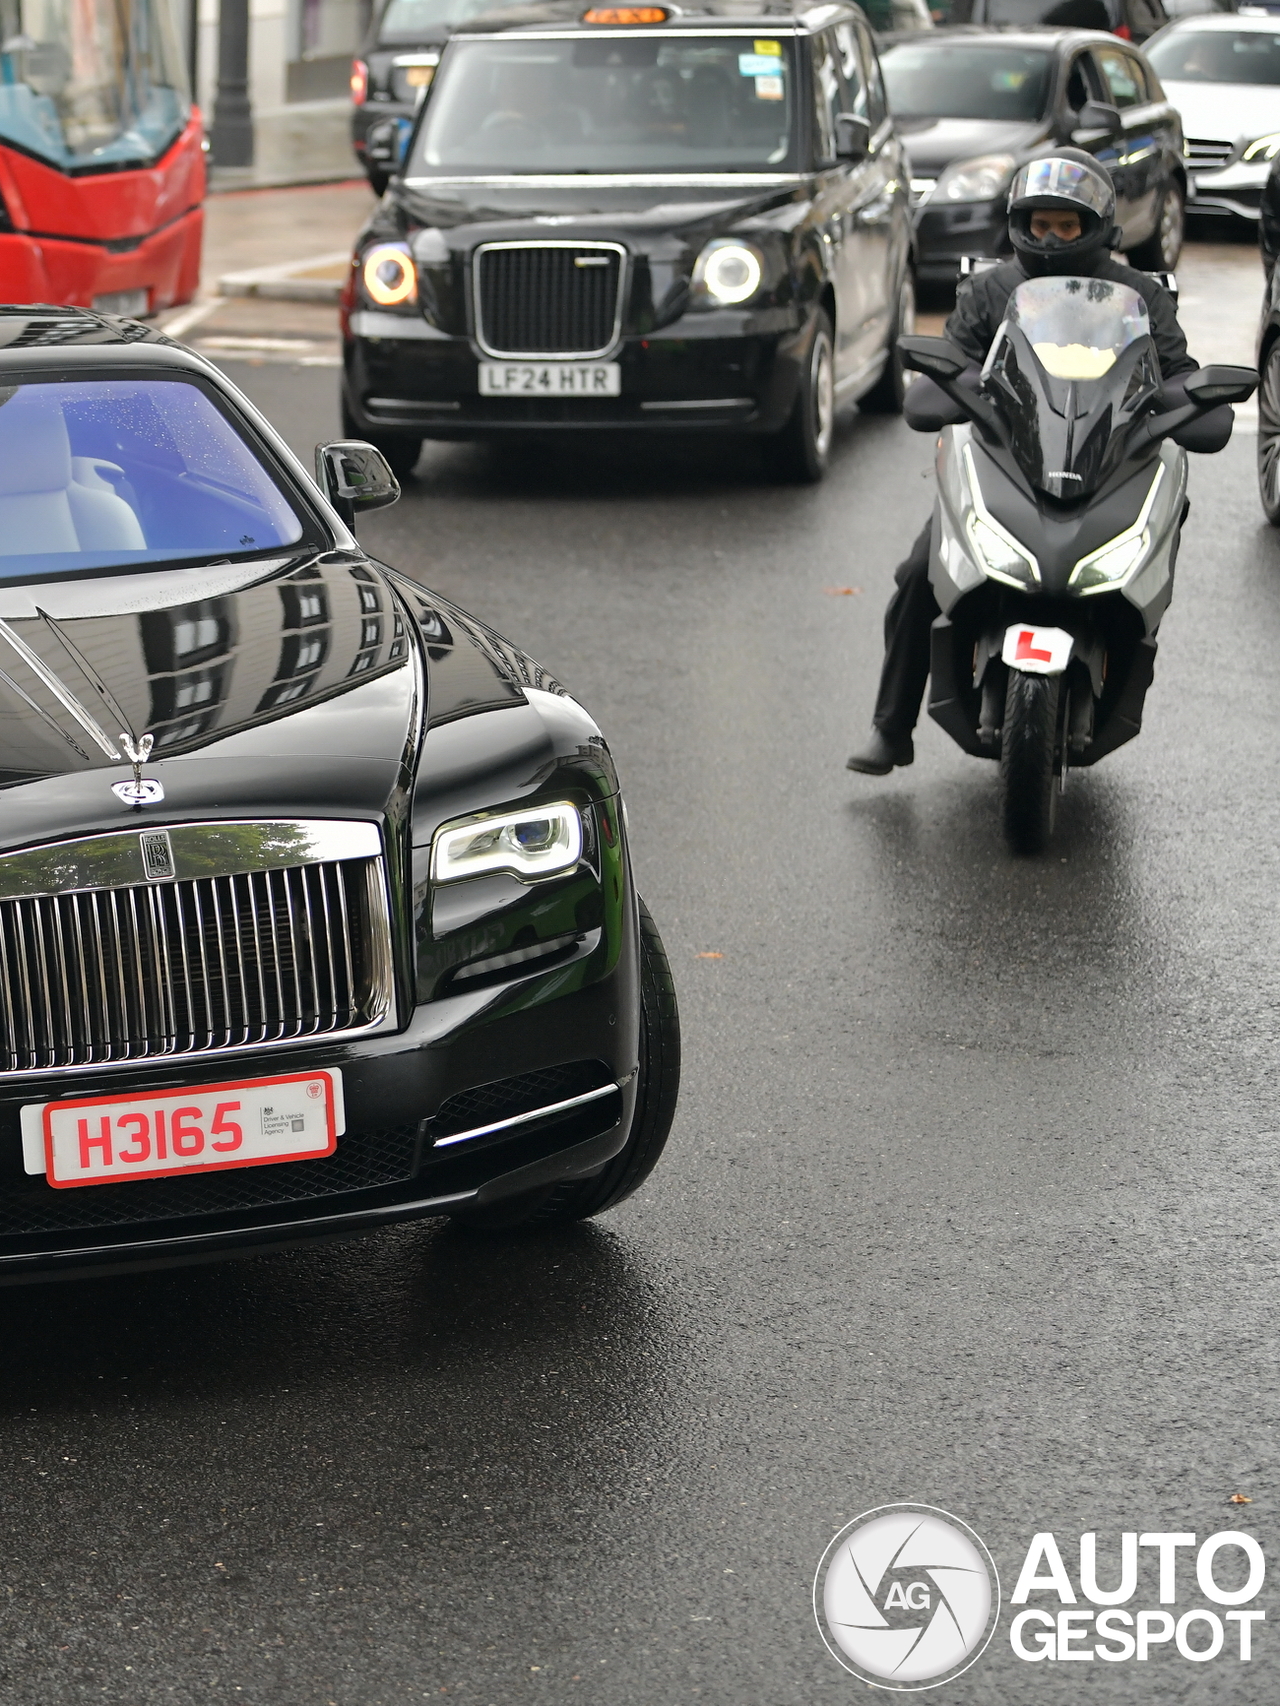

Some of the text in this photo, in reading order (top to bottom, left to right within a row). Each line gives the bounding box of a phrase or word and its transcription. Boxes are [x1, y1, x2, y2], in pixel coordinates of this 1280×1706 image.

[488, 367, 608, 389] LF24 HTR
[1048, 471, 1083, 481] HONDA
[1015, 631, 1052, 663] L
[77, 1101, 243, 1168] H3165
[264, 1121, 289, 1129] Licensing
